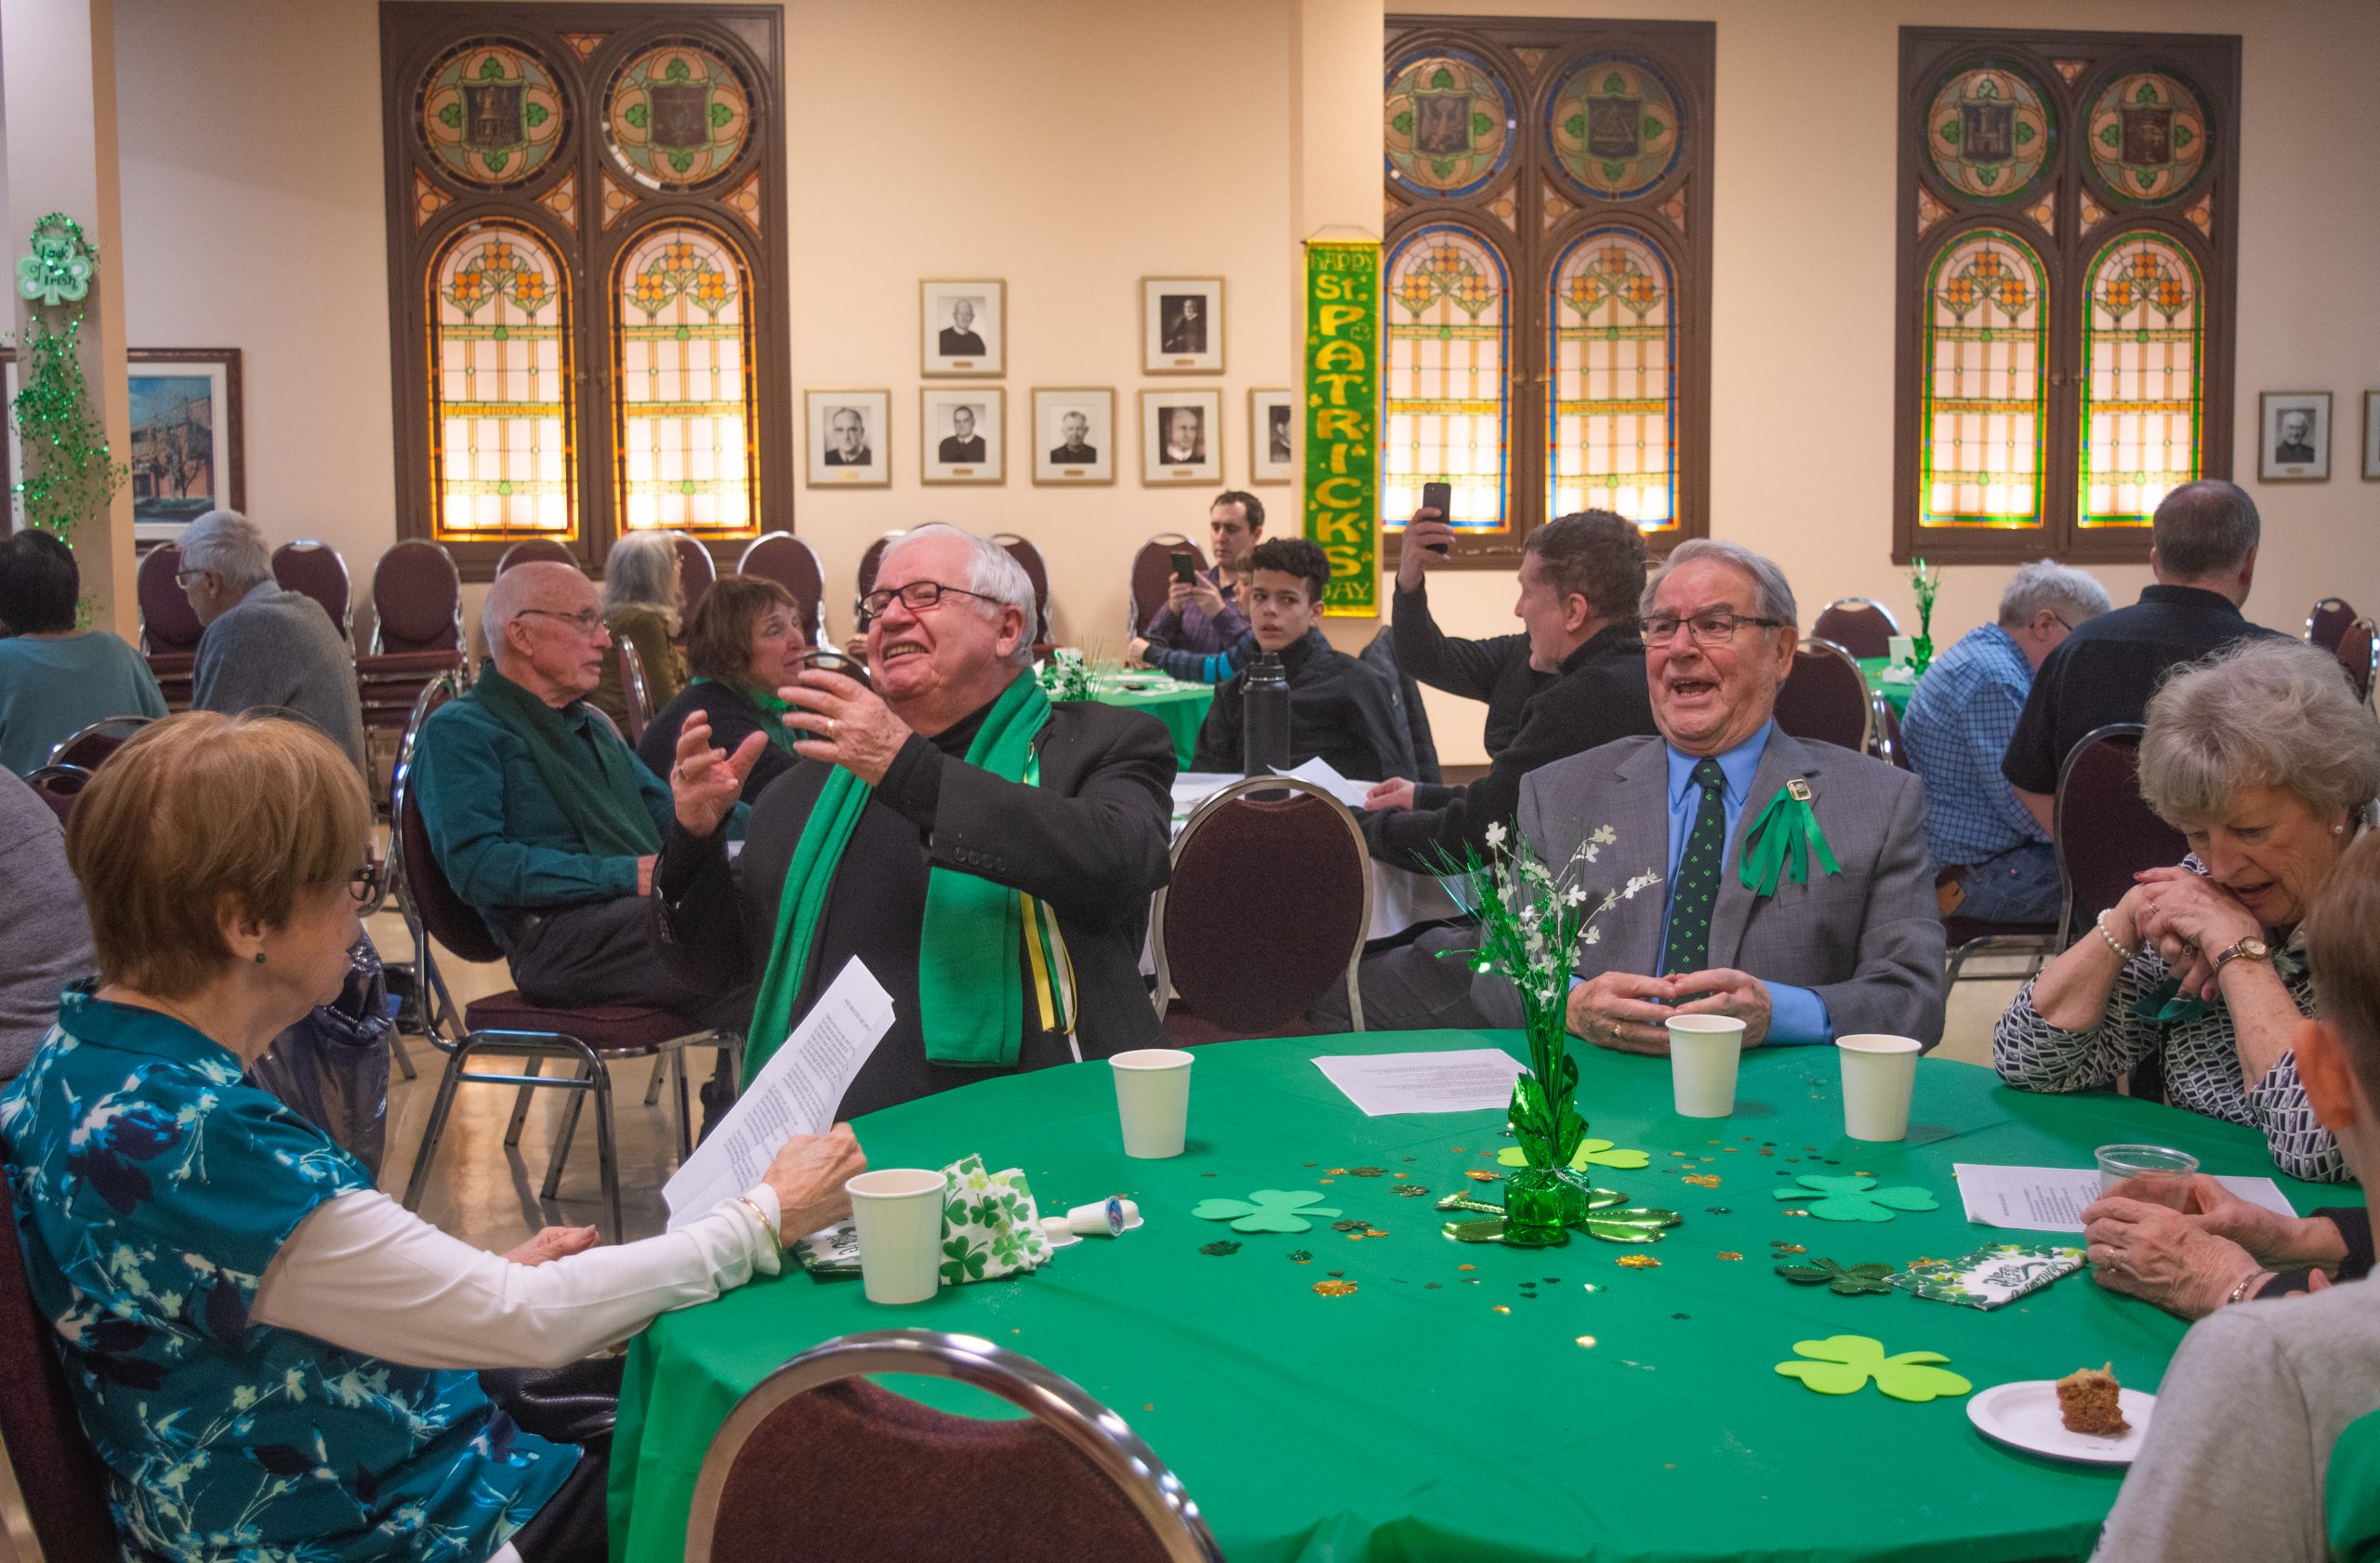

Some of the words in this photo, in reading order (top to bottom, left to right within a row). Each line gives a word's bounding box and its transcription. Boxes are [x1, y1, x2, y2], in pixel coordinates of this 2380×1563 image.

[30, 264, 44, 283] of
[44, 275, 78, 290] Irish
[1315, 273, 1368, 301] St.
